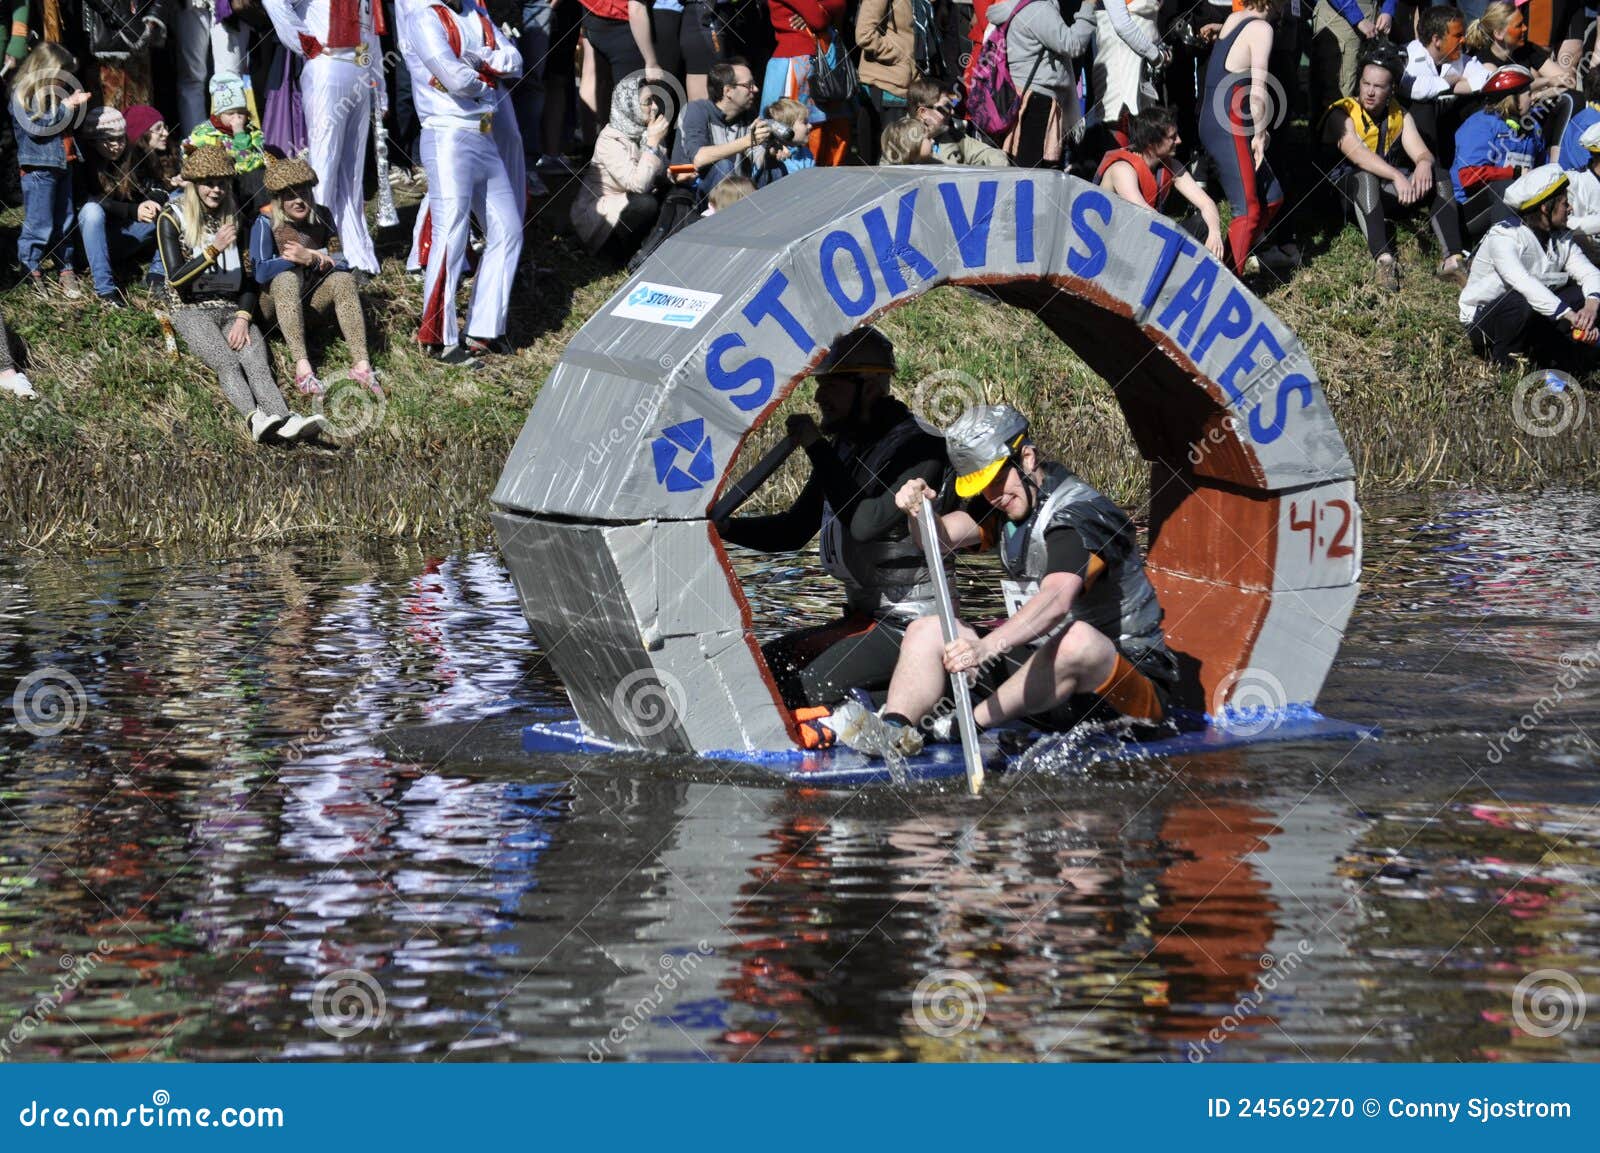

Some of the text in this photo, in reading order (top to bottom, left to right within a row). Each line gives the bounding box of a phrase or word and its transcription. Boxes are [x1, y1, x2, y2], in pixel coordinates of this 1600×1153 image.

[647, 292, 688, 308] STOKVIS
[705, 180, 1312, 445] STOKVIS TAPES
[1289, 500, 1354, 563] 4:2
